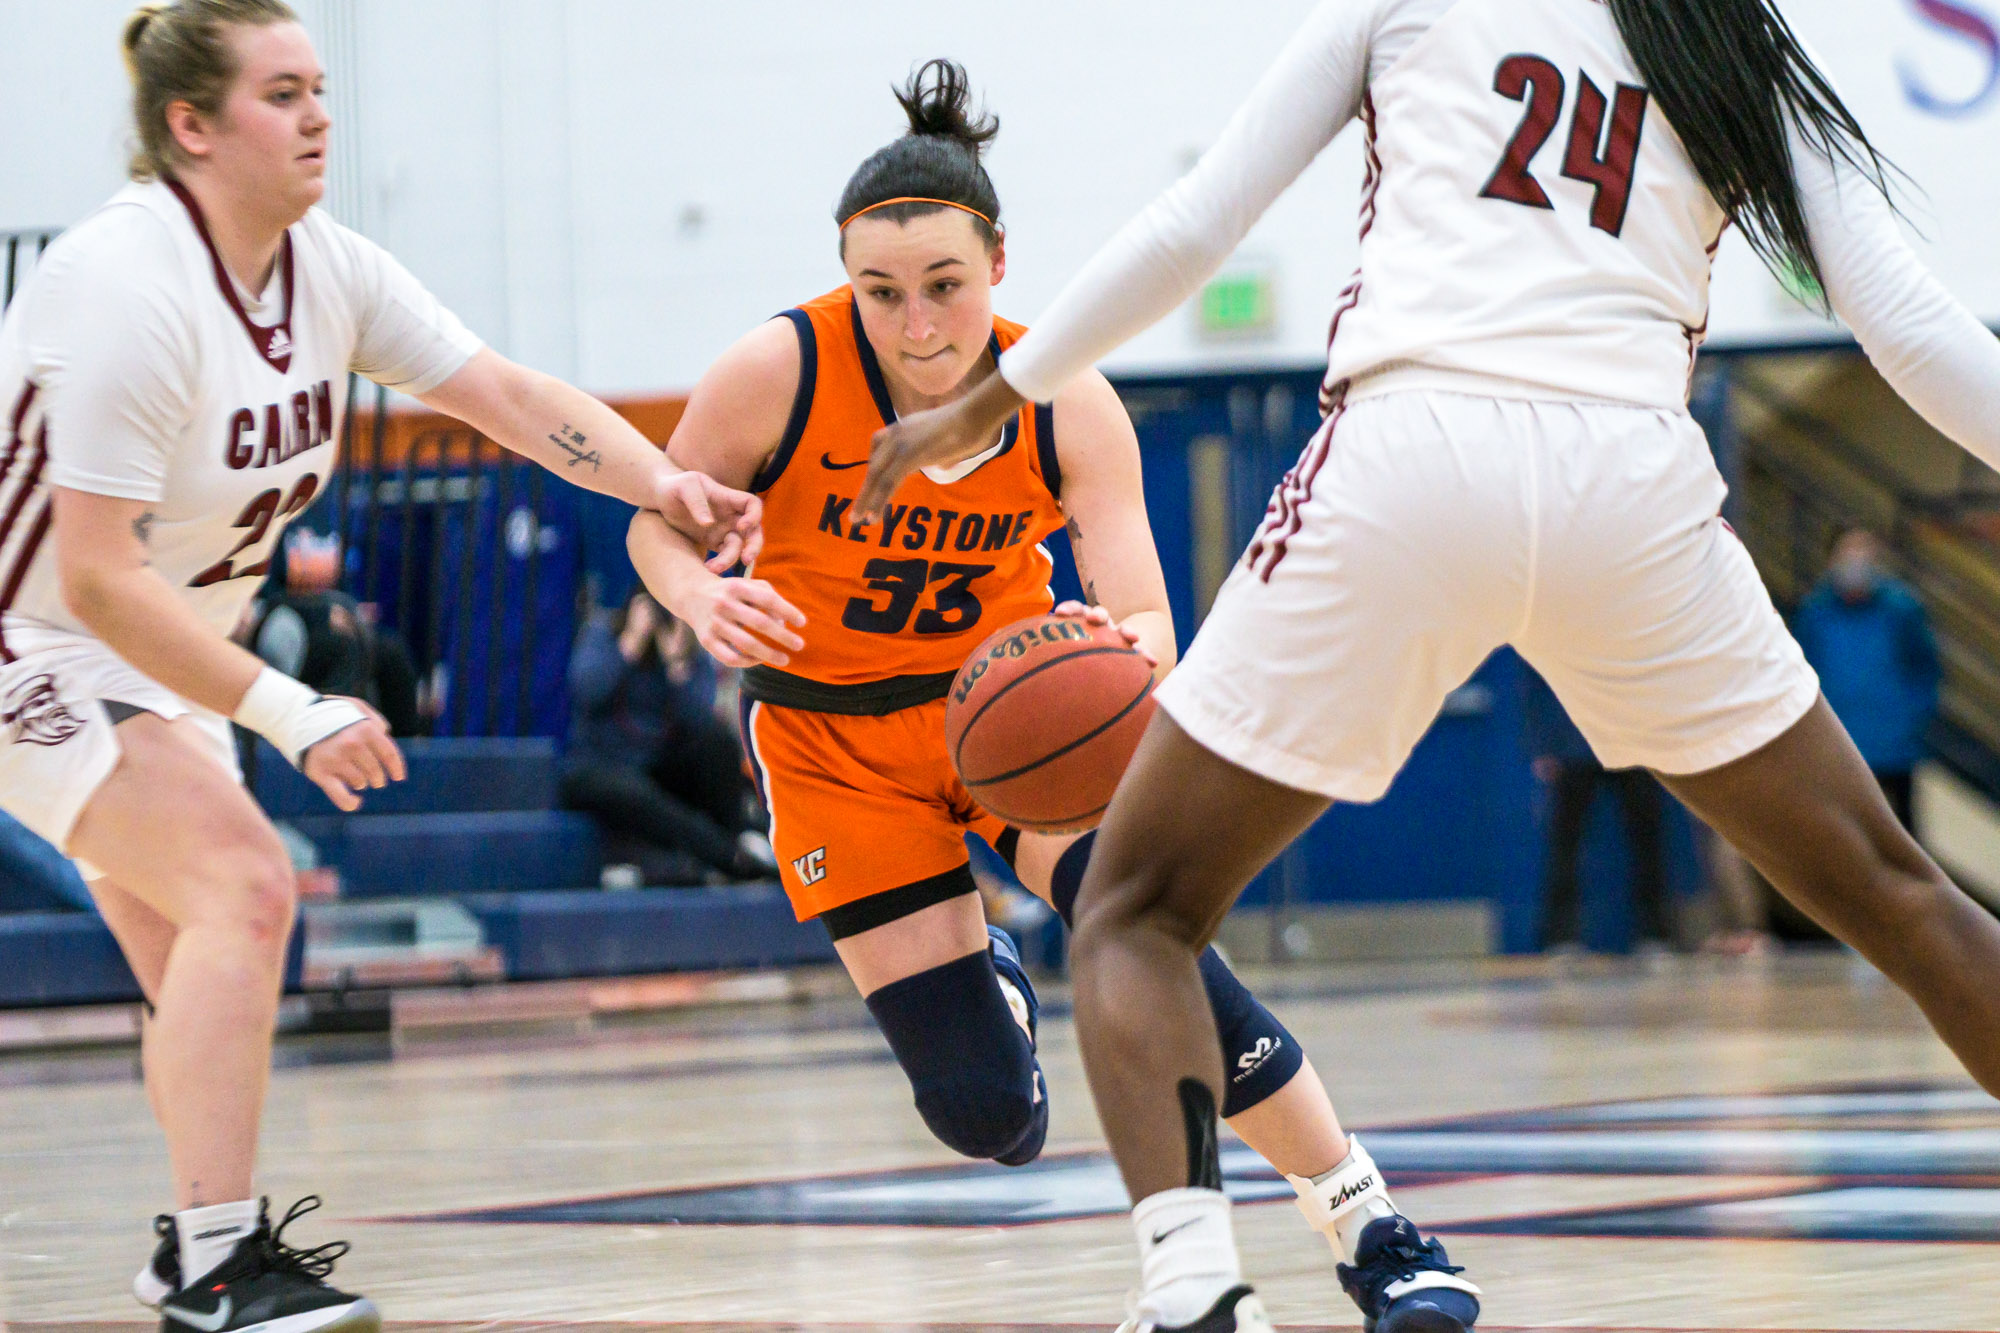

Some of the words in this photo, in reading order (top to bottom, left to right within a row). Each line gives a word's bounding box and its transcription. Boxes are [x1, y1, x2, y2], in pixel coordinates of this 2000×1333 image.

[1478, 53, 1649, 238] 24
[841, 558, 995, 634] 33
[955, 620, 1093, 704] Wilson
[791, 845, 826, 887] KC
[1329, 1173, 1374, 1211] ZAMST
